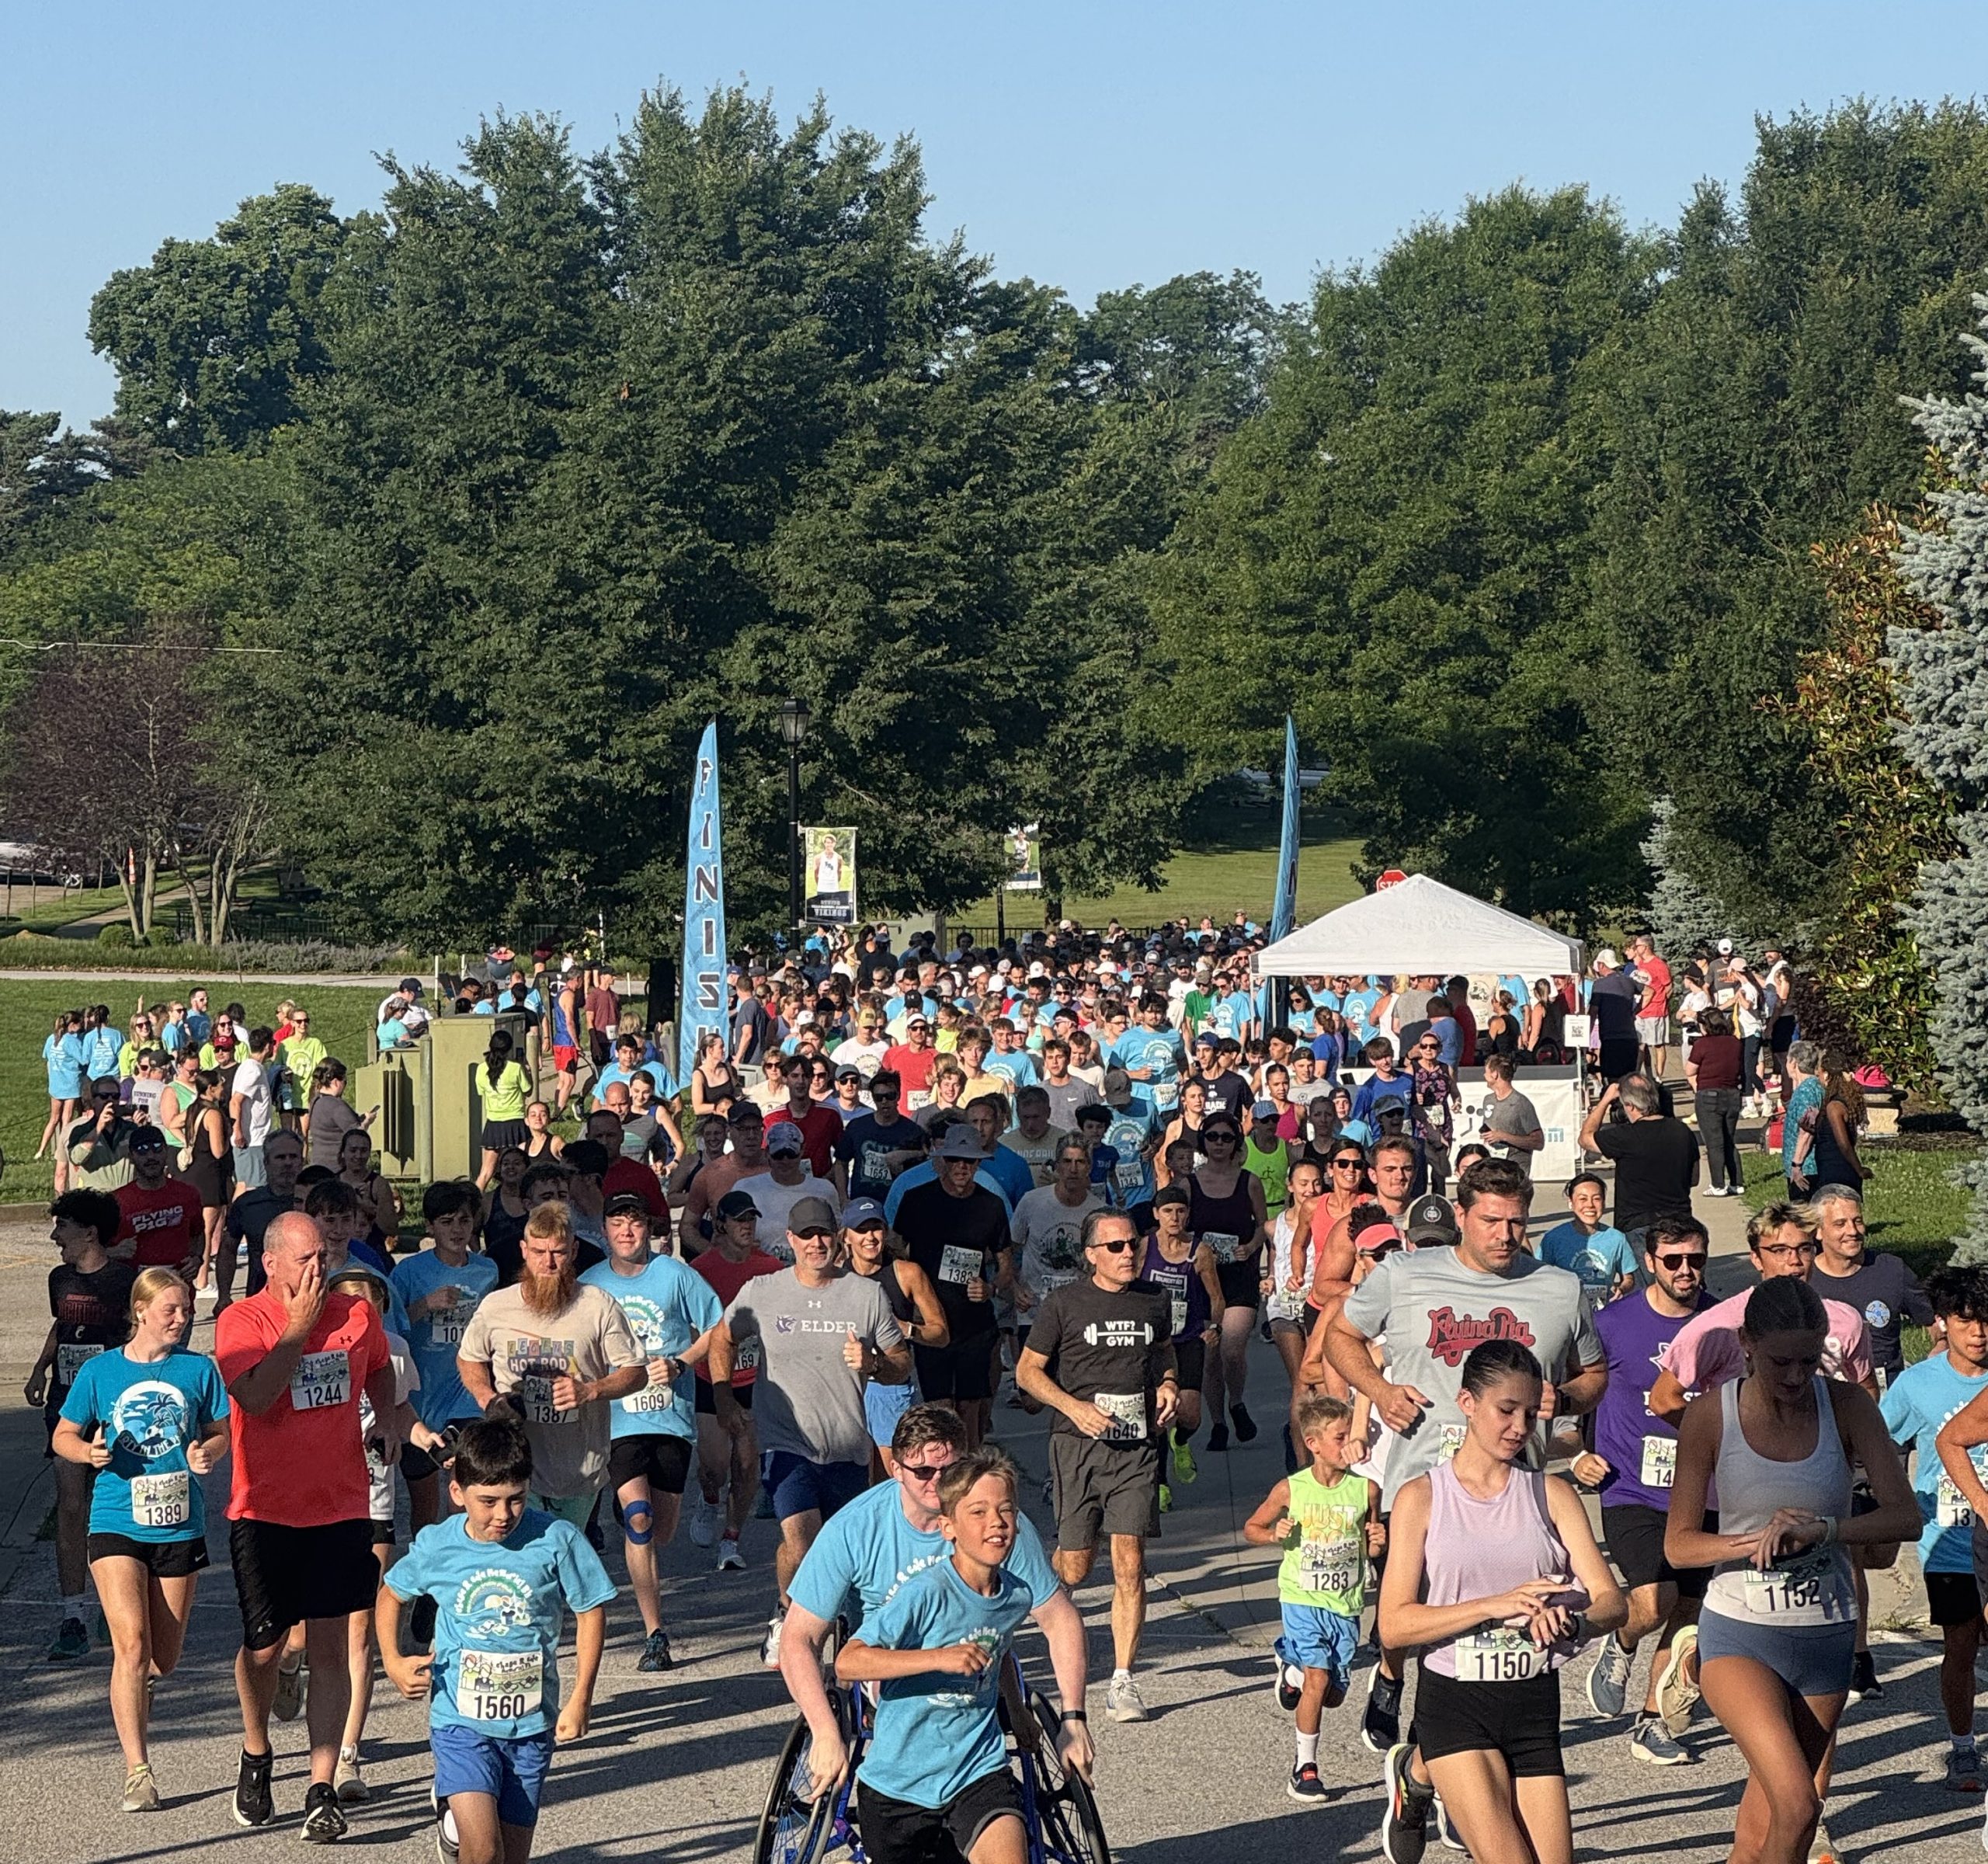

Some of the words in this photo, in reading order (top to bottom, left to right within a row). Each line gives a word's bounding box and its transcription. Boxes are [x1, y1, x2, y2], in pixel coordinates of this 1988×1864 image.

[870, 1167, 888, 1180] 1653
[1120, 1177, 1138, 1189] 1343
[132, 1205, 183, 1225] FLYING
[135, 1218, 168, 1233] PIG
[1288, 1305, 1305, 1317] 154
[443, 1326, 466, 1342] 101
[801, 1320, 858, 1334] ELDER
[1104, 1320, 1135, 1330] WTF?
[1428, 1307, 1496, 1350] Flying
[1489, 1307, 1531, 1341] Pig
[1107, 1336, 1135, 1346] GYM
[510, 1358, 536, 1372] HOT
[540, 1357, 568, 1371] ROD
[737, 1353, 754, 1370] 169
[304, 1383, 342, 1407] 1244
[633, 1394, 665, 1412] 1609
[533, 1404, 568, 1424] 1387
[1107, 1422, 1138, 1439] 1640
[152, 1439, 171, 1456] THE
[1655, 1468, 1672, 1486] 14
[145, 1504, 181, 1525] 1389
[1303, 1503, 1357, 1530] JUST
[1952, 1508, 1970, 1527] 13
[1312, 1571, 1349, 1591] 1283
[1764, 1578, 1821, 1612] 1152
[1475, 1650, 1531, 1680] 1150
[474, 1694, 525, 1720] 1560
